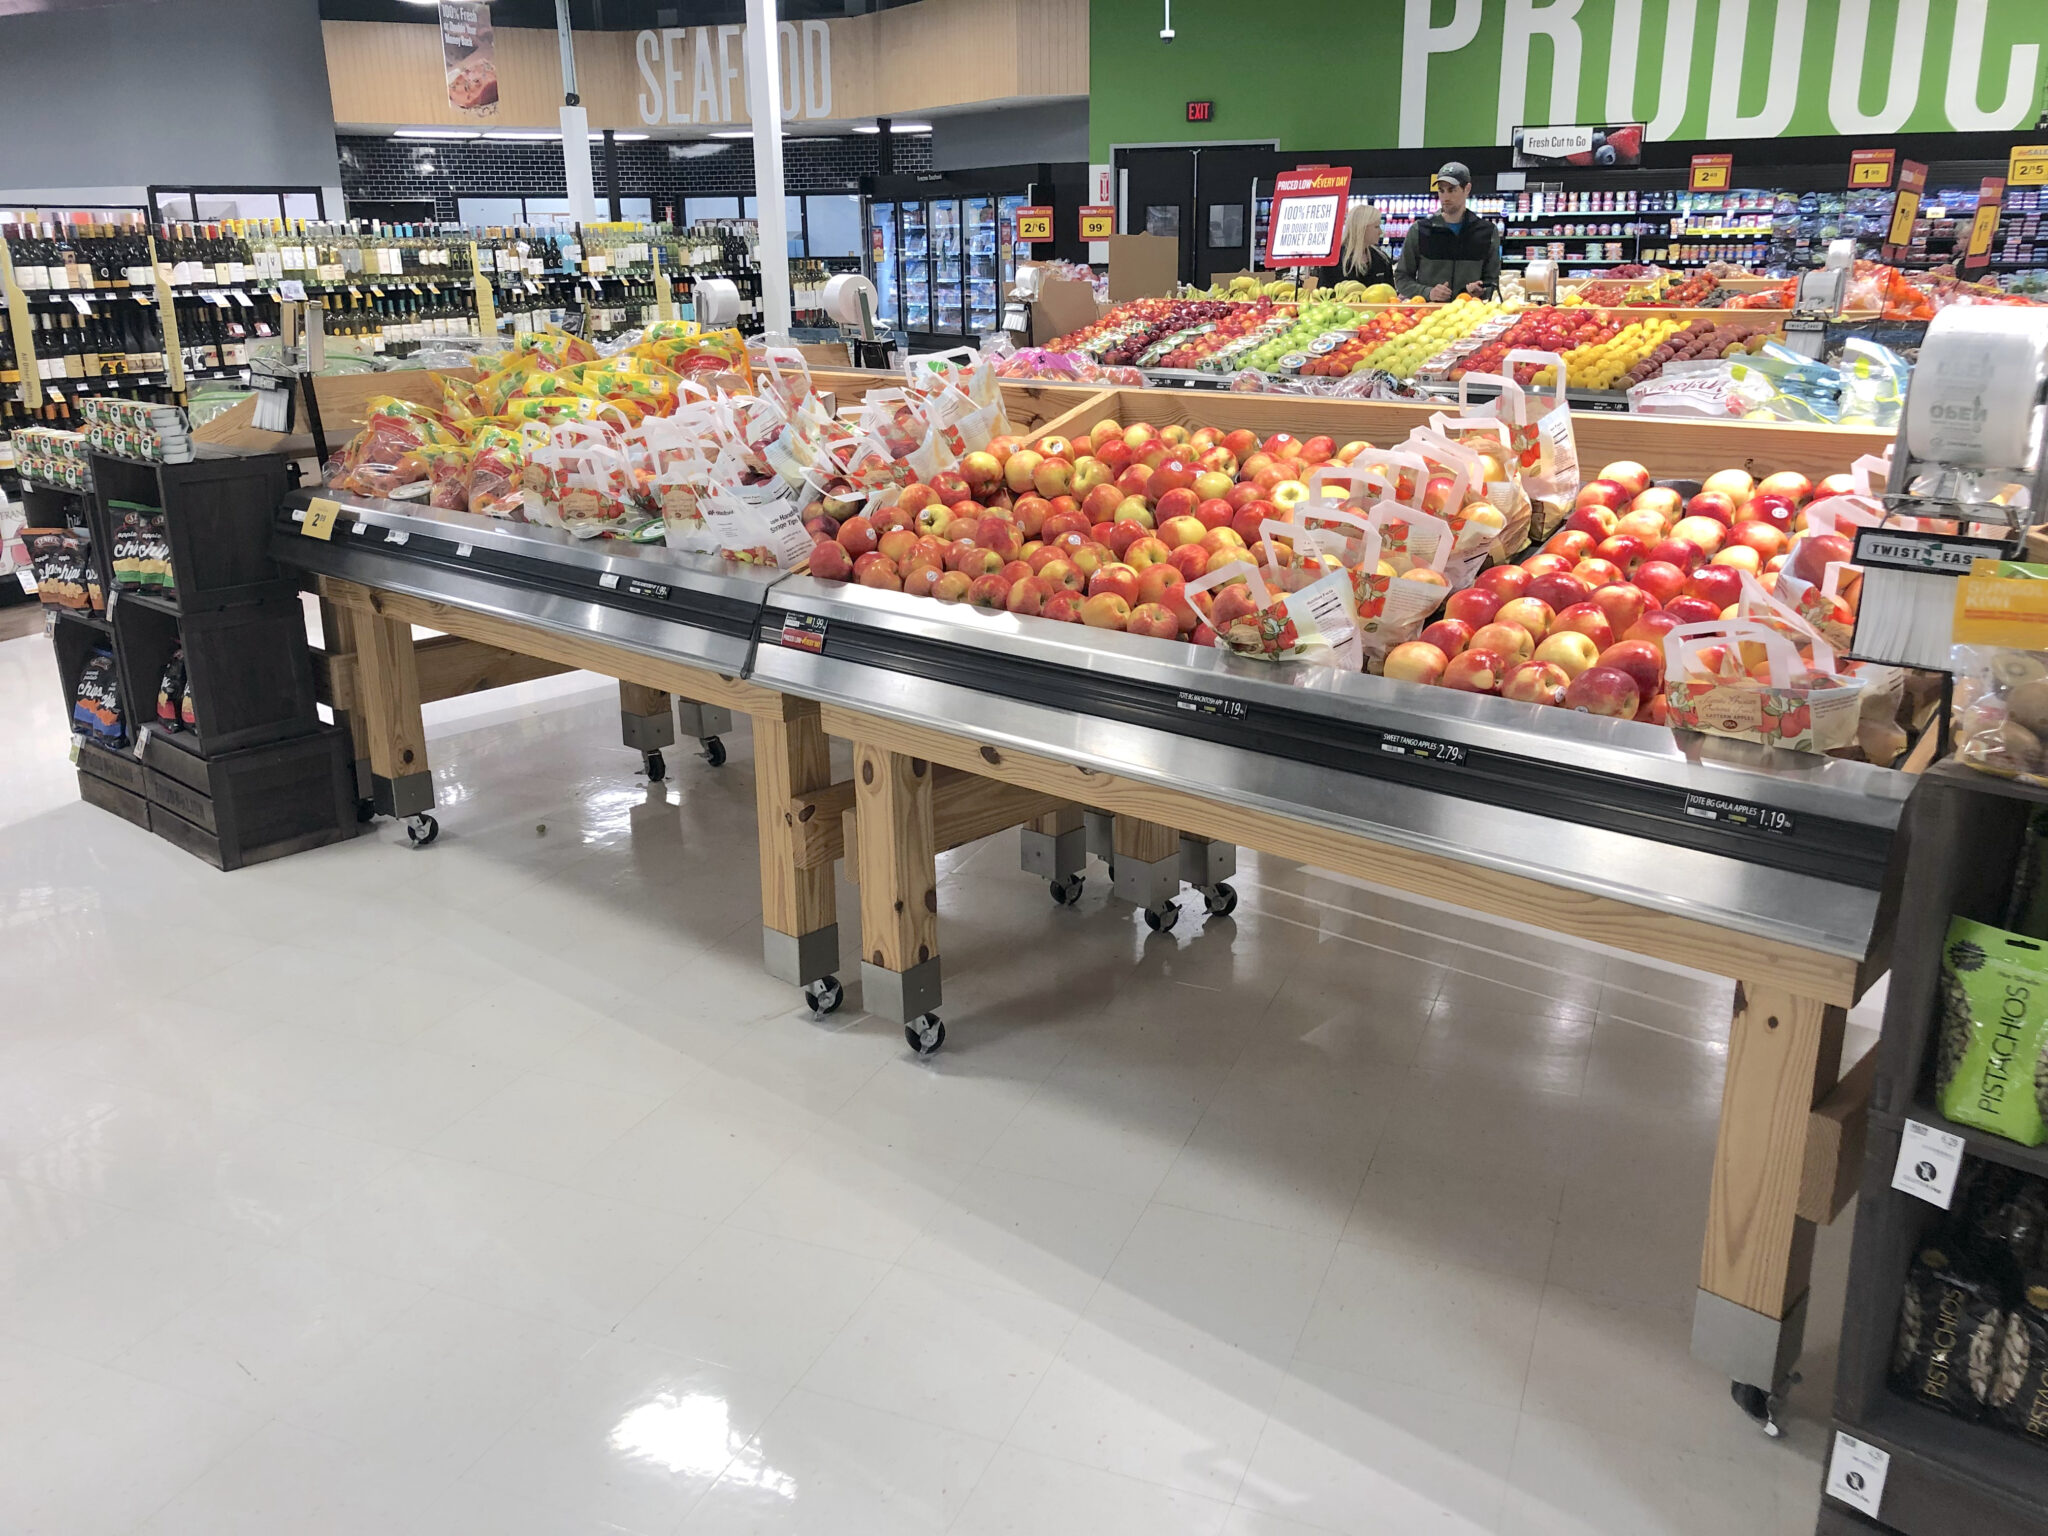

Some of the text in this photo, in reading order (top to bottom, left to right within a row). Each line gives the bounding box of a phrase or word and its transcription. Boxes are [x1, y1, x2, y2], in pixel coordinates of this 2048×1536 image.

[1188, 103, 1209, 120] EXIT
[1529, 136, 1586, 148] Fresh Cut to Go
[1277, 179, 1299, 191] PRICED
[1299, 179, 1312, 190] LOW
[1335, 176, 1348, 187] DAY
[1284, 204, 1332, 220] 100% FRESH
[1282, 222, 1329, 233] OR DOUBLE YOUR
[1280, 232, 1327, 246] MONEY BACK
[1872, 543, 1920, 559] TWIST
[78, 681, 103, 699] chips
[1223, 700, 1241, 716] 1.19
[1383, 733, 1437, 750] SWEET TANGO APPLES
[1436, 744, 1459, 761] 2.79
[1689, 794, 1757, 816] TOTE BG GALA APPLES
[1759, 809, 1786, 829] 1.19
[1977, 984, 2030, 1115] PISTACHIOS
[1923, 1288, 1965, 1399] PISTACHIOS
